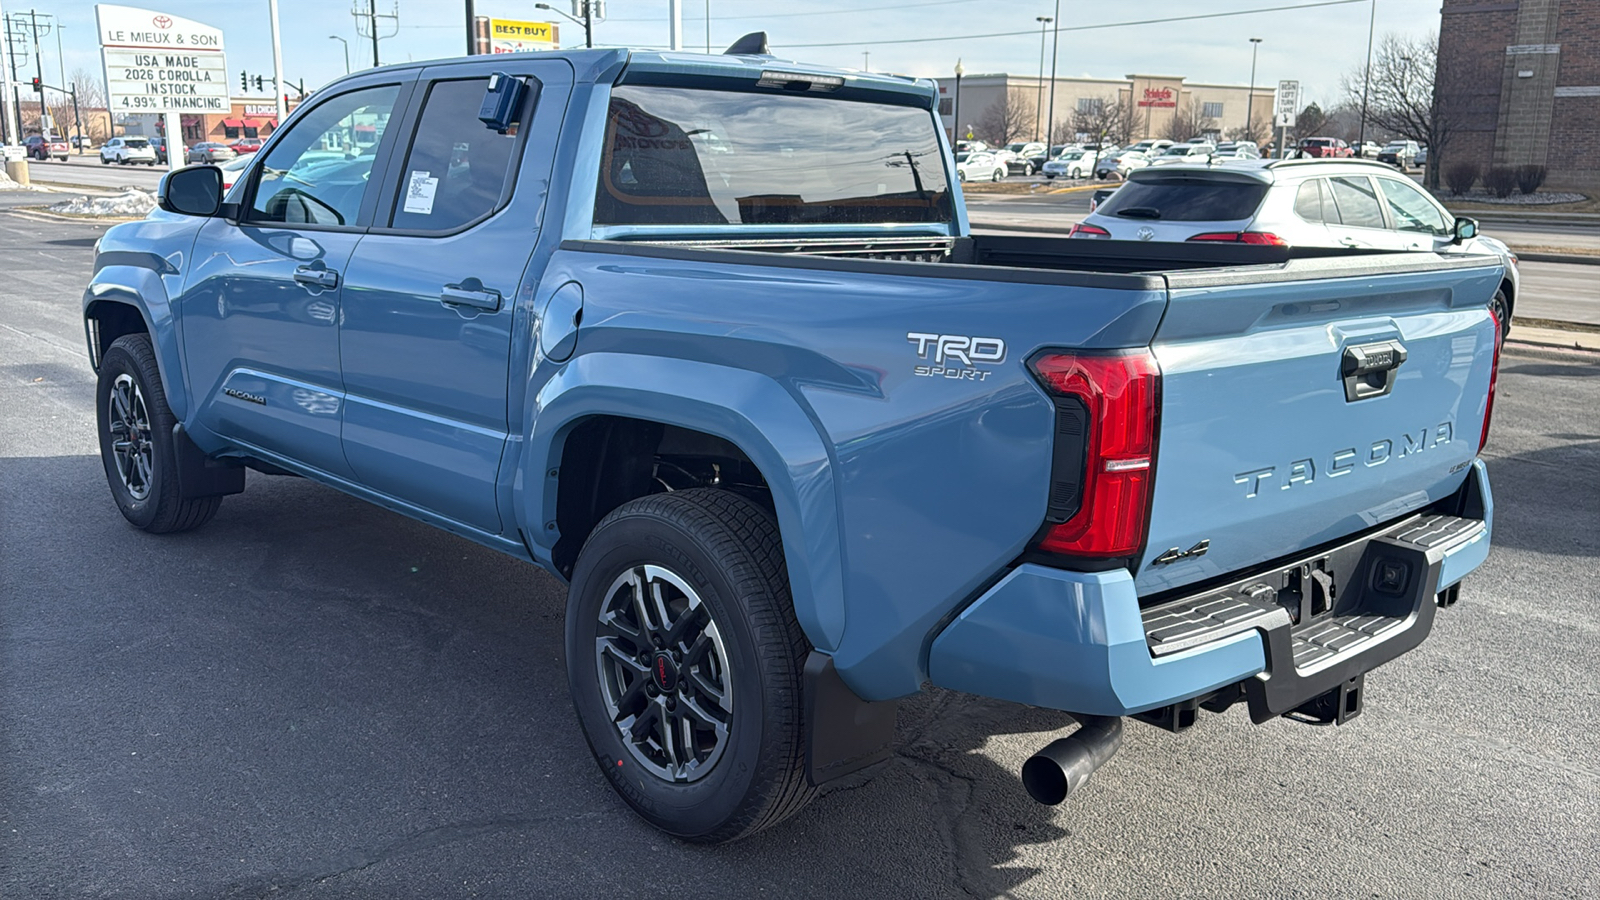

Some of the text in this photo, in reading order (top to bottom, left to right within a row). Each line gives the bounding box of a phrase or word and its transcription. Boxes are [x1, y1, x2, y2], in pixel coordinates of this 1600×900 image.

[495, 24, 548, 37] BEST BUY
[108, 30, 218, 46] LE MIEUX & SON
[135, 55, 199, 68] USA MADE
[125, 69, 212, 82] 2026 COROLLA
[121, 96, 221, 109] 4.99% FINANCING
[1279, 106, 1293, 114] LANE
[906, 332, 1007, 368] TRD
[914, 366, 992, 381] SPORT
[223, 387, 267, 406] TACOMA
[1233, 421, 1453, 499] TACOMA
